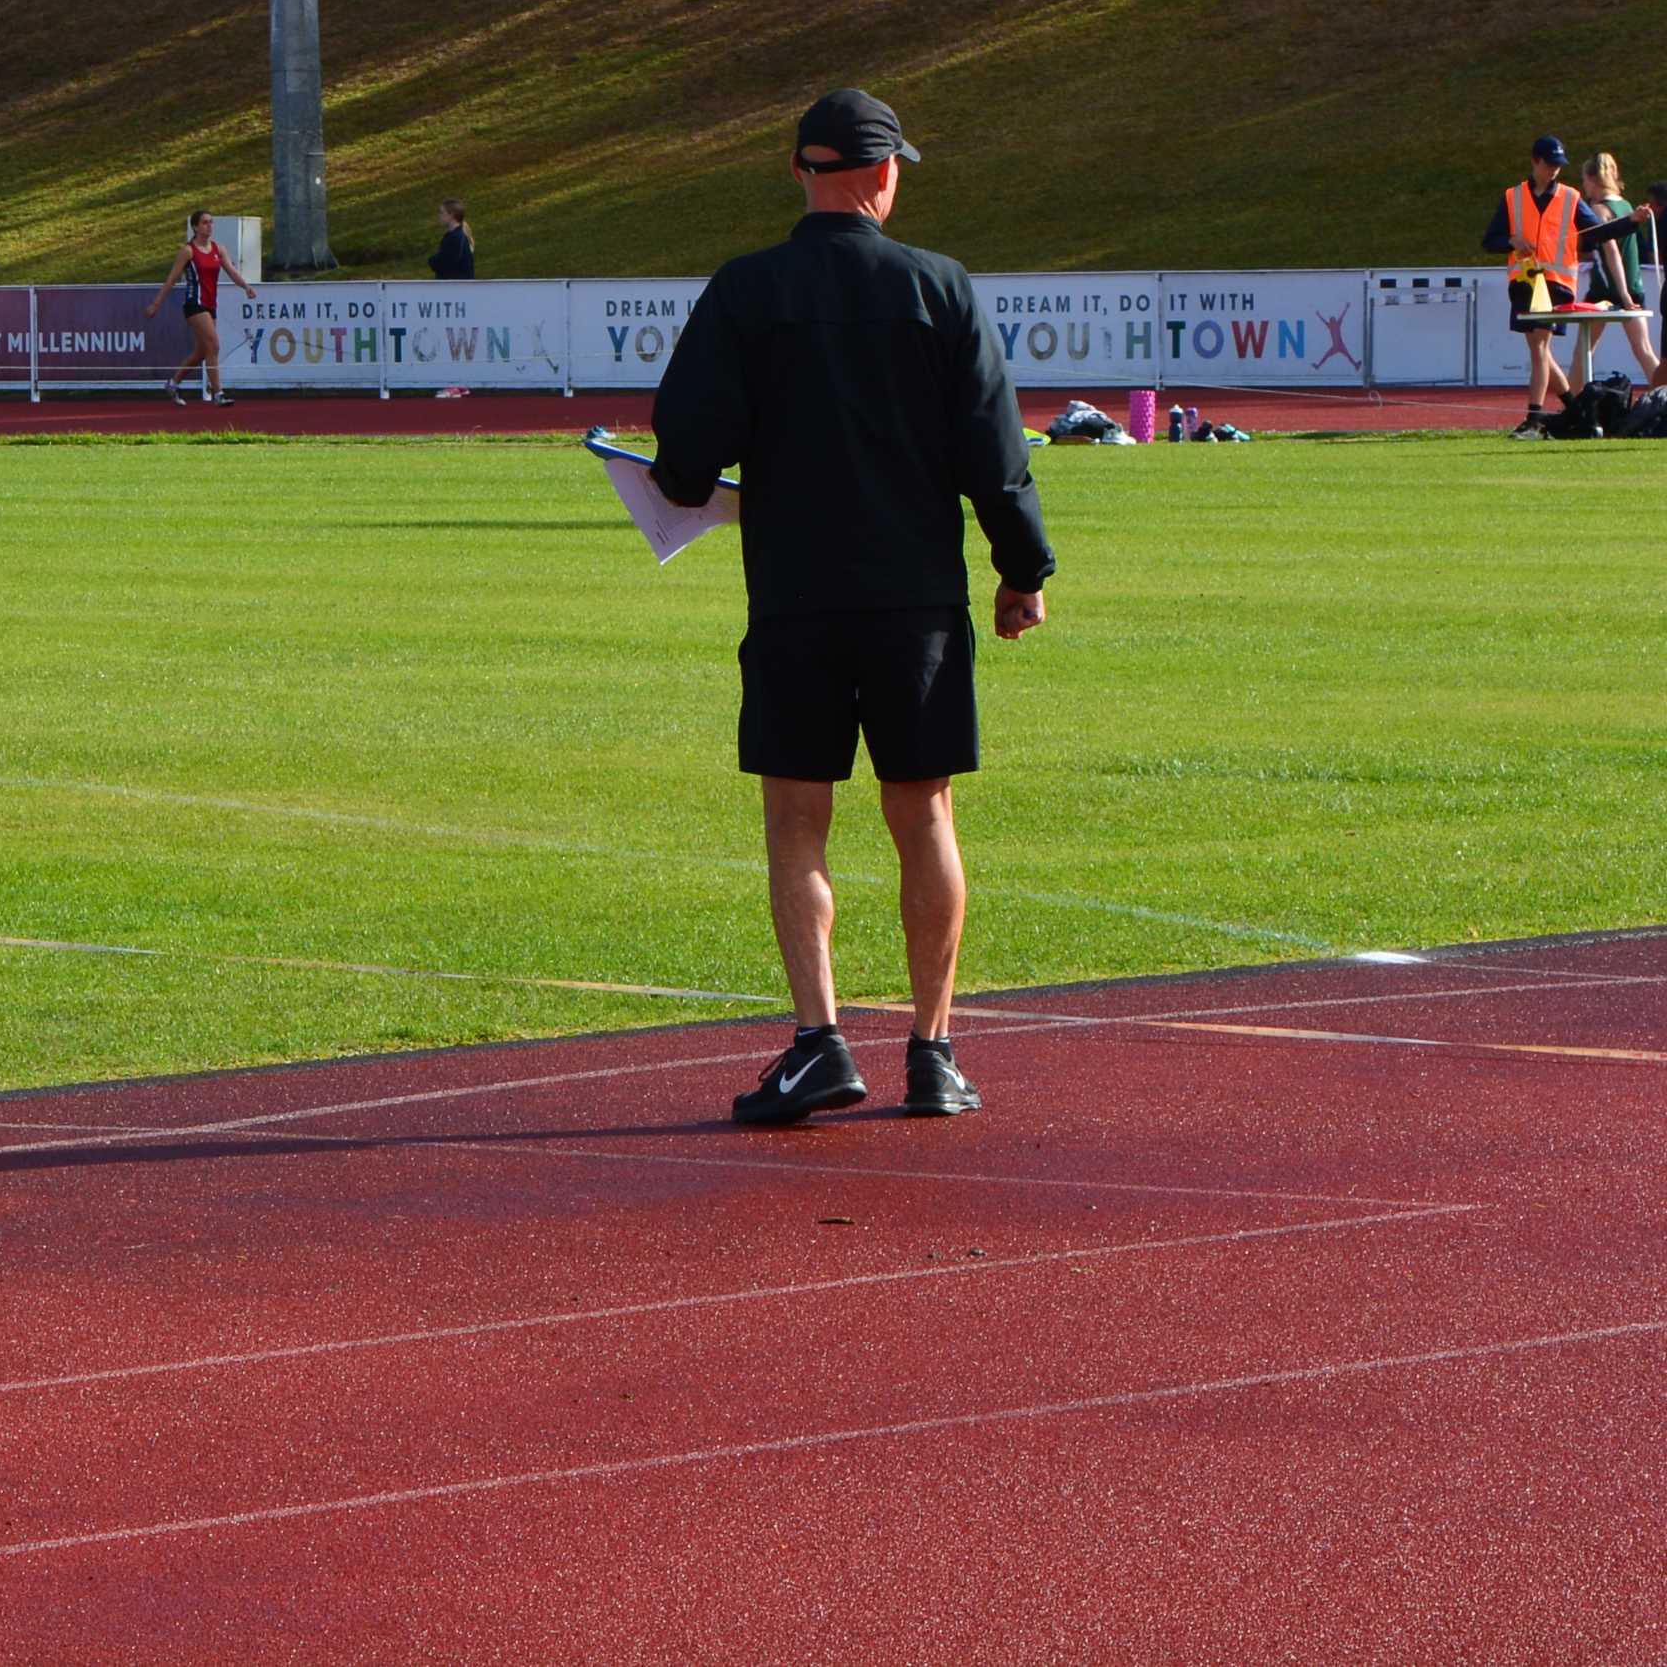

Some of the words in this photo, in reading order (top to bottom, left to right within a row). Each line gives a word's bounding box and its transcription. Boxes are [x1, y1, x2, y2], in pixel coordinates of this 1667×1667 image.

[242, 303, 306, 320] DREAM
[317, 303, 338, 322] IT,
[348, 302, 376, 319] DO
[392, 302, 408, 319] IT
[418, 302, 467, 319] WITH
[606, 300, 675, 317] DREAM
[996, 296, 1071, 313] DREAM
[1083, 295, 1107, 315] IT,
[1120, 294, 1151, 311] DO
[1170, 294, 1188, 311] IT
[1200, 293, 1255, 311] WITH
[8, 331, 146, 353] MILLENNIUM
